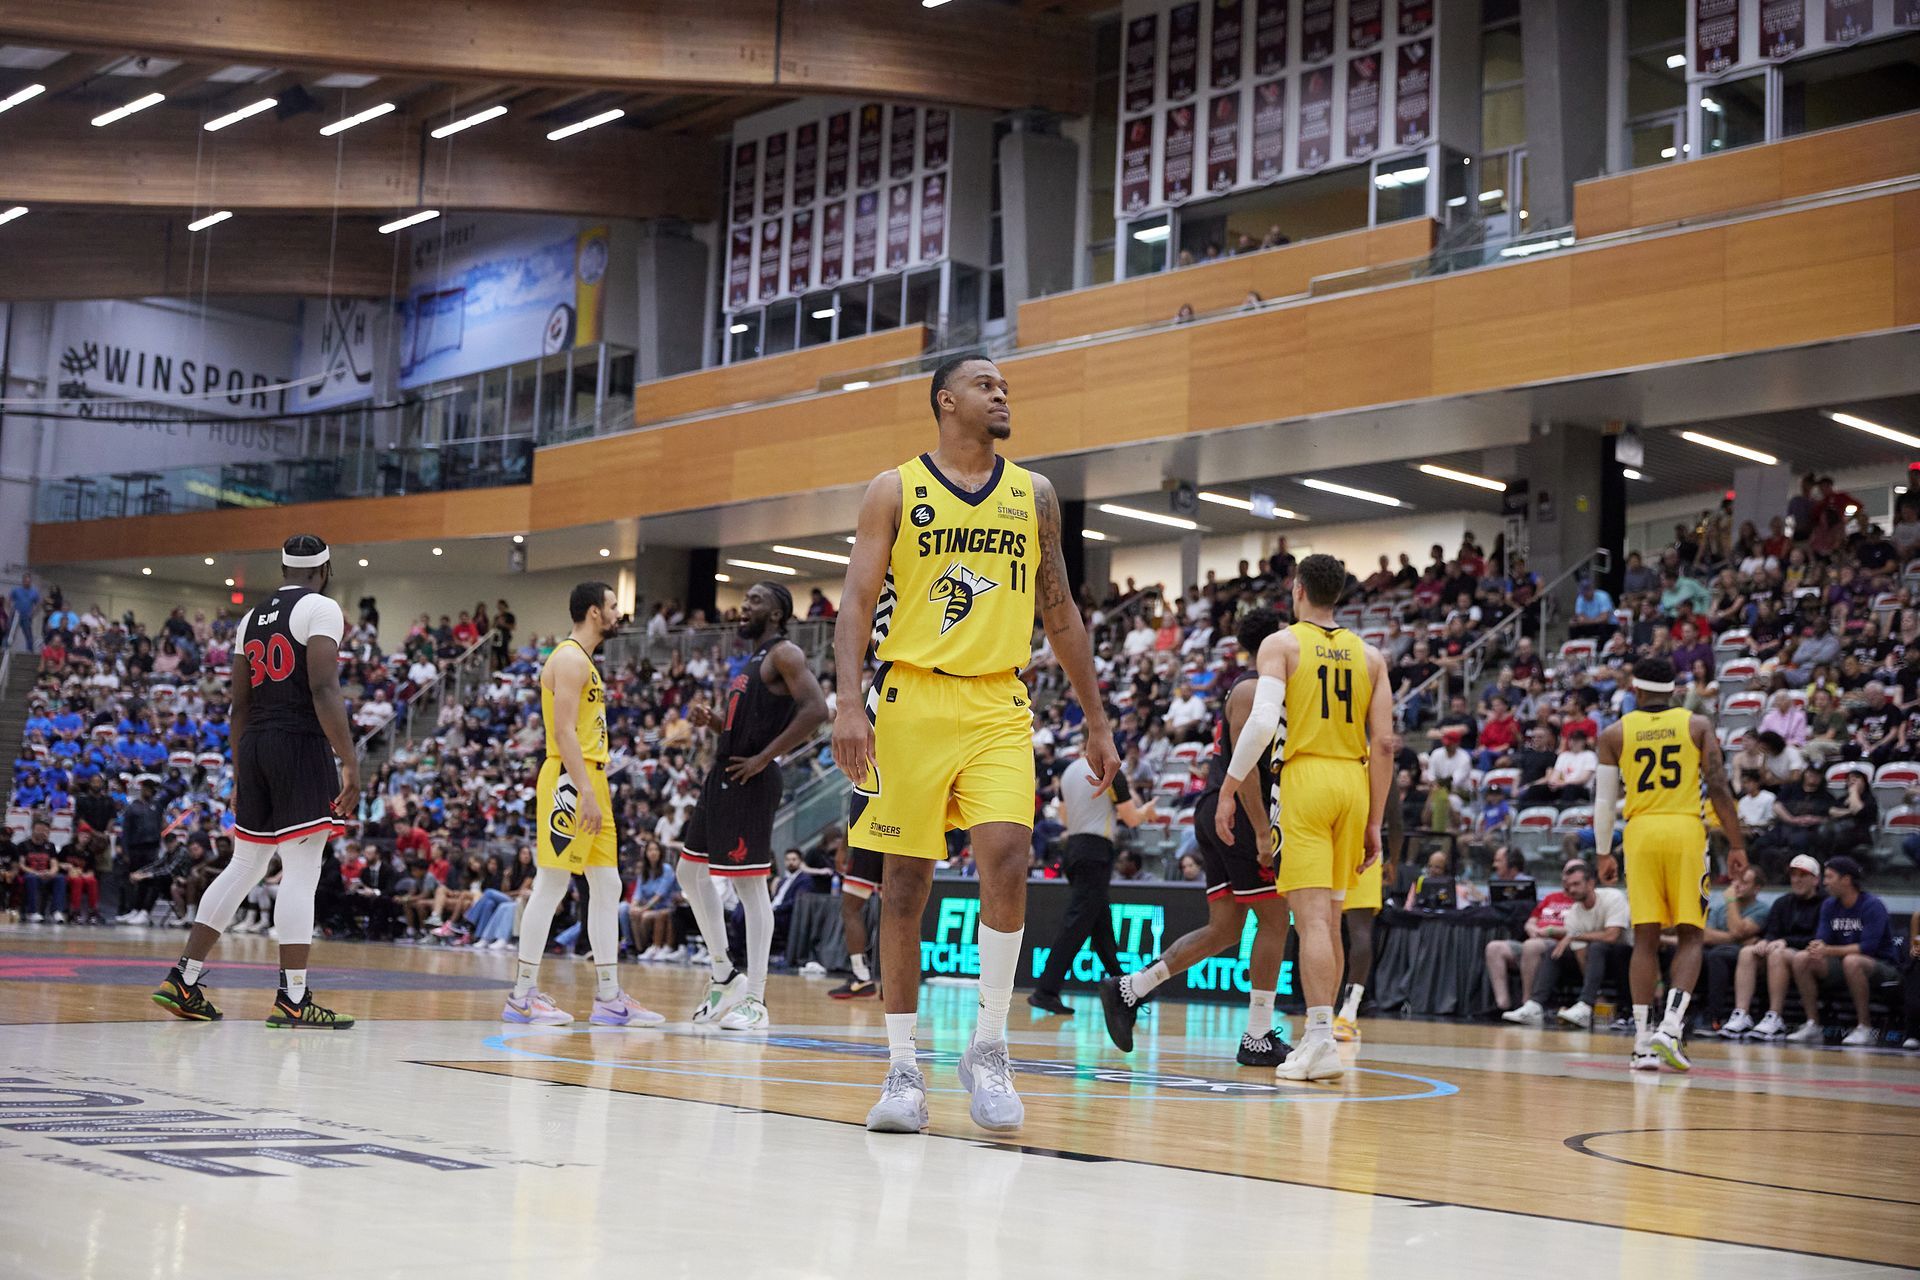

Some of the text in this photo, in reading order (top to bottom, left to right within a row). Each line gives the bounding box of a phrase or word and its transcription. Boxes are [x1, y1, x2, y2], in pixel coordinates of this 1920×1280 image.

[105, 345, 292, 416] WINSPORT
[918, 527, 1027, 558] STINGERS
[1010, 560, 1026, 594] 11
[244, 632, 296, 688] 30
[1317, 664, 1353, 723] 14
[1635, 728, 1676, 742] GIBSON
[1634, 744, 1682, 793] 25
[870, 821, 901, 835] STINGERS
[935, 897, 981, 945] FI
